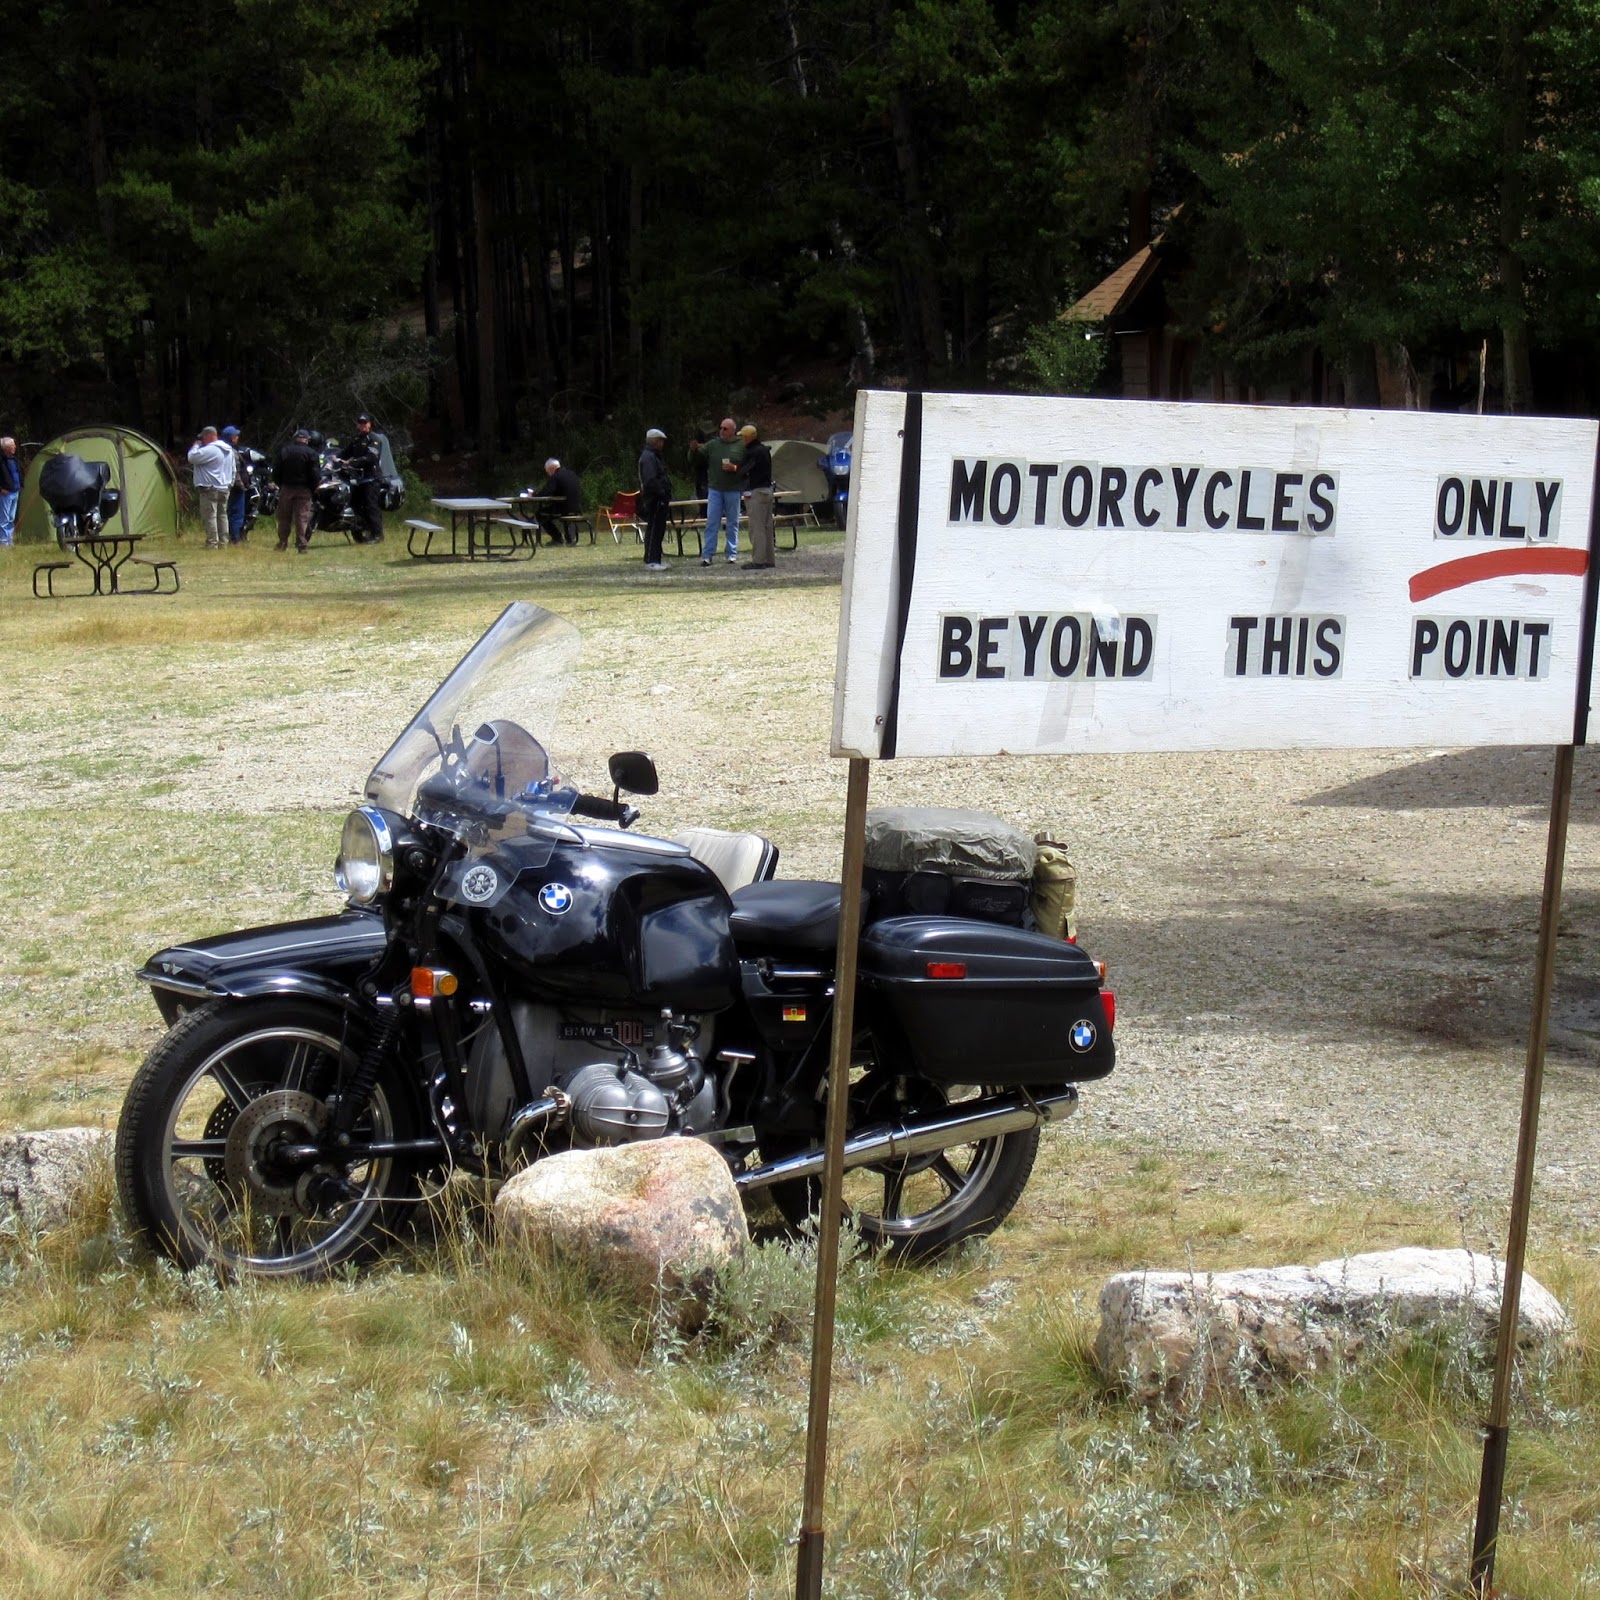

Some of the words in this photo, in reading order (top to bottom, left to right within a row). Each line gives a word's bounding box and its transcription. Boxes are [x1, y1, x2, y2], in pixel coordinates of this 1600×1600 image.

[950, 460, 1335, 531] MOTORCYCLES
[1438, 478, 1560, 539] ONLY
[940, 616, 1153, 679] BEYOND
[1231, 617, 1341, 677] THIS
[1413, 619, 1549, 678] POINT
